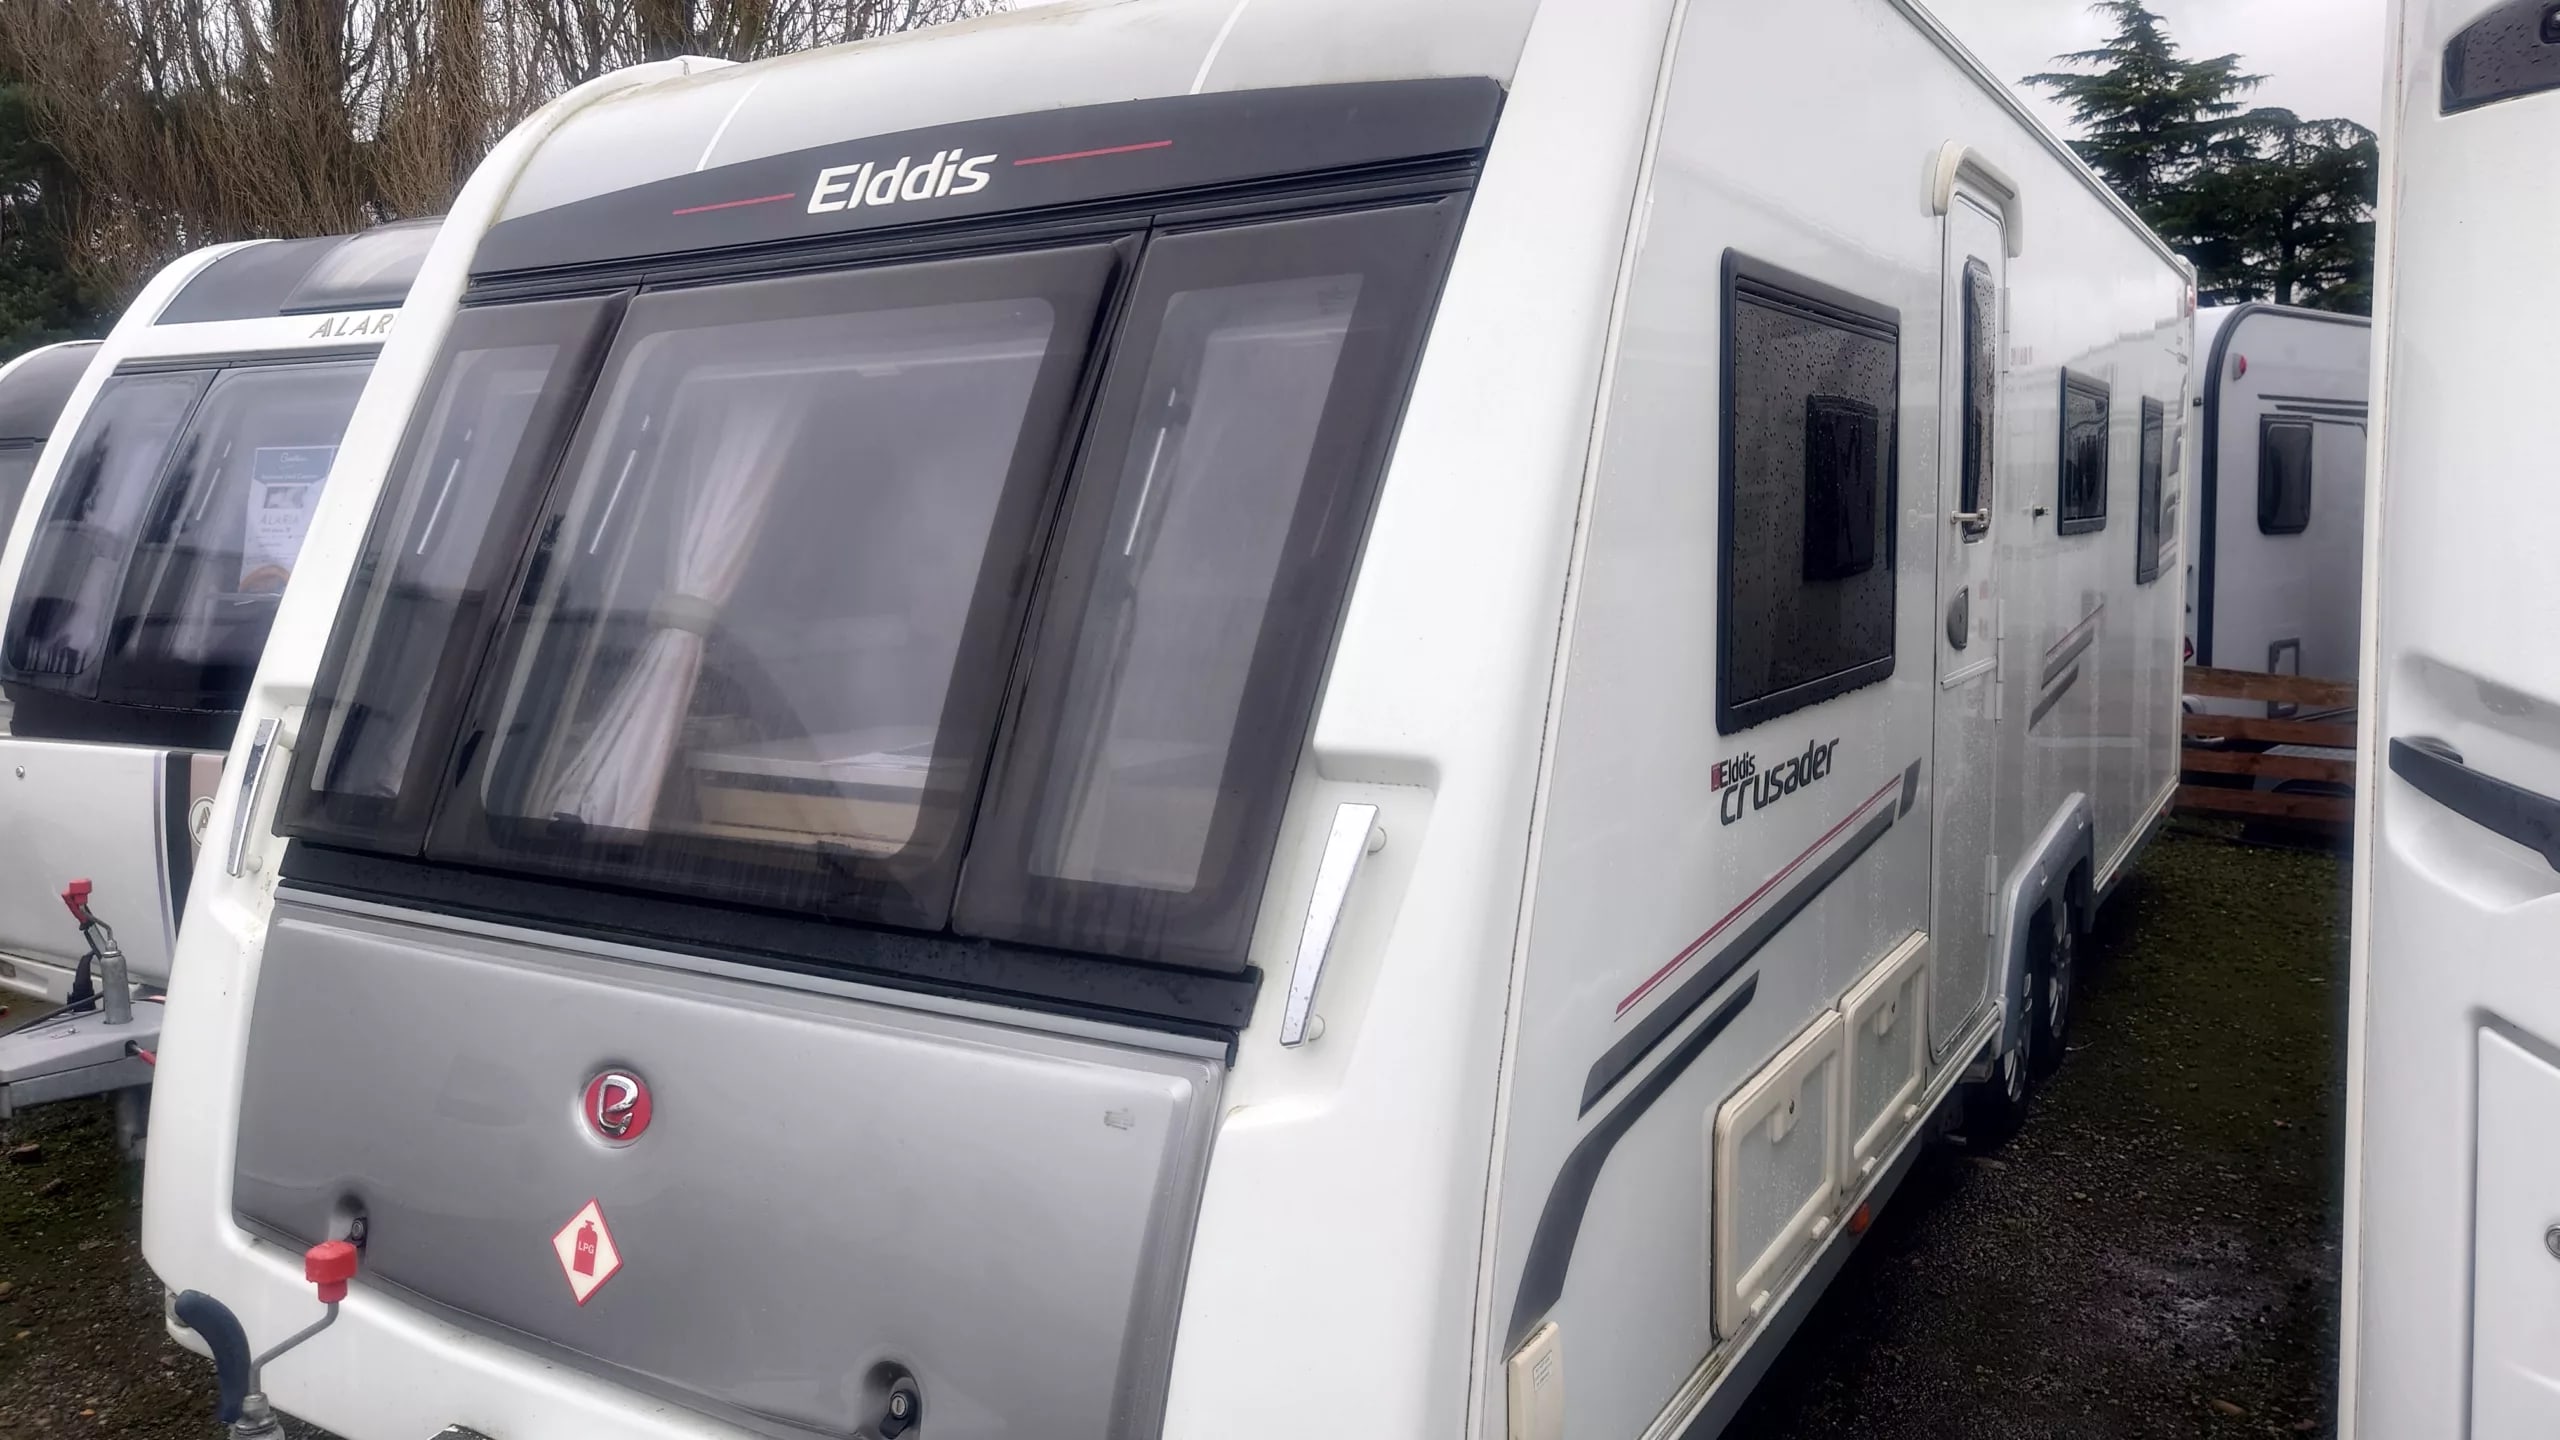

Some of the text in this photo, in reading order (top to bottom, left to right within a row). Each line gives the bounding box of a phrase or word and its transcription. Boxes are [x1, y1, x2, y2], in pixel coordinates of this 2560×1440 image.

[807, 148, 999, 214] Elddis
[1719, 751, 1756, 789] Elddis
[577, 1240, 595, 1255] LPG
